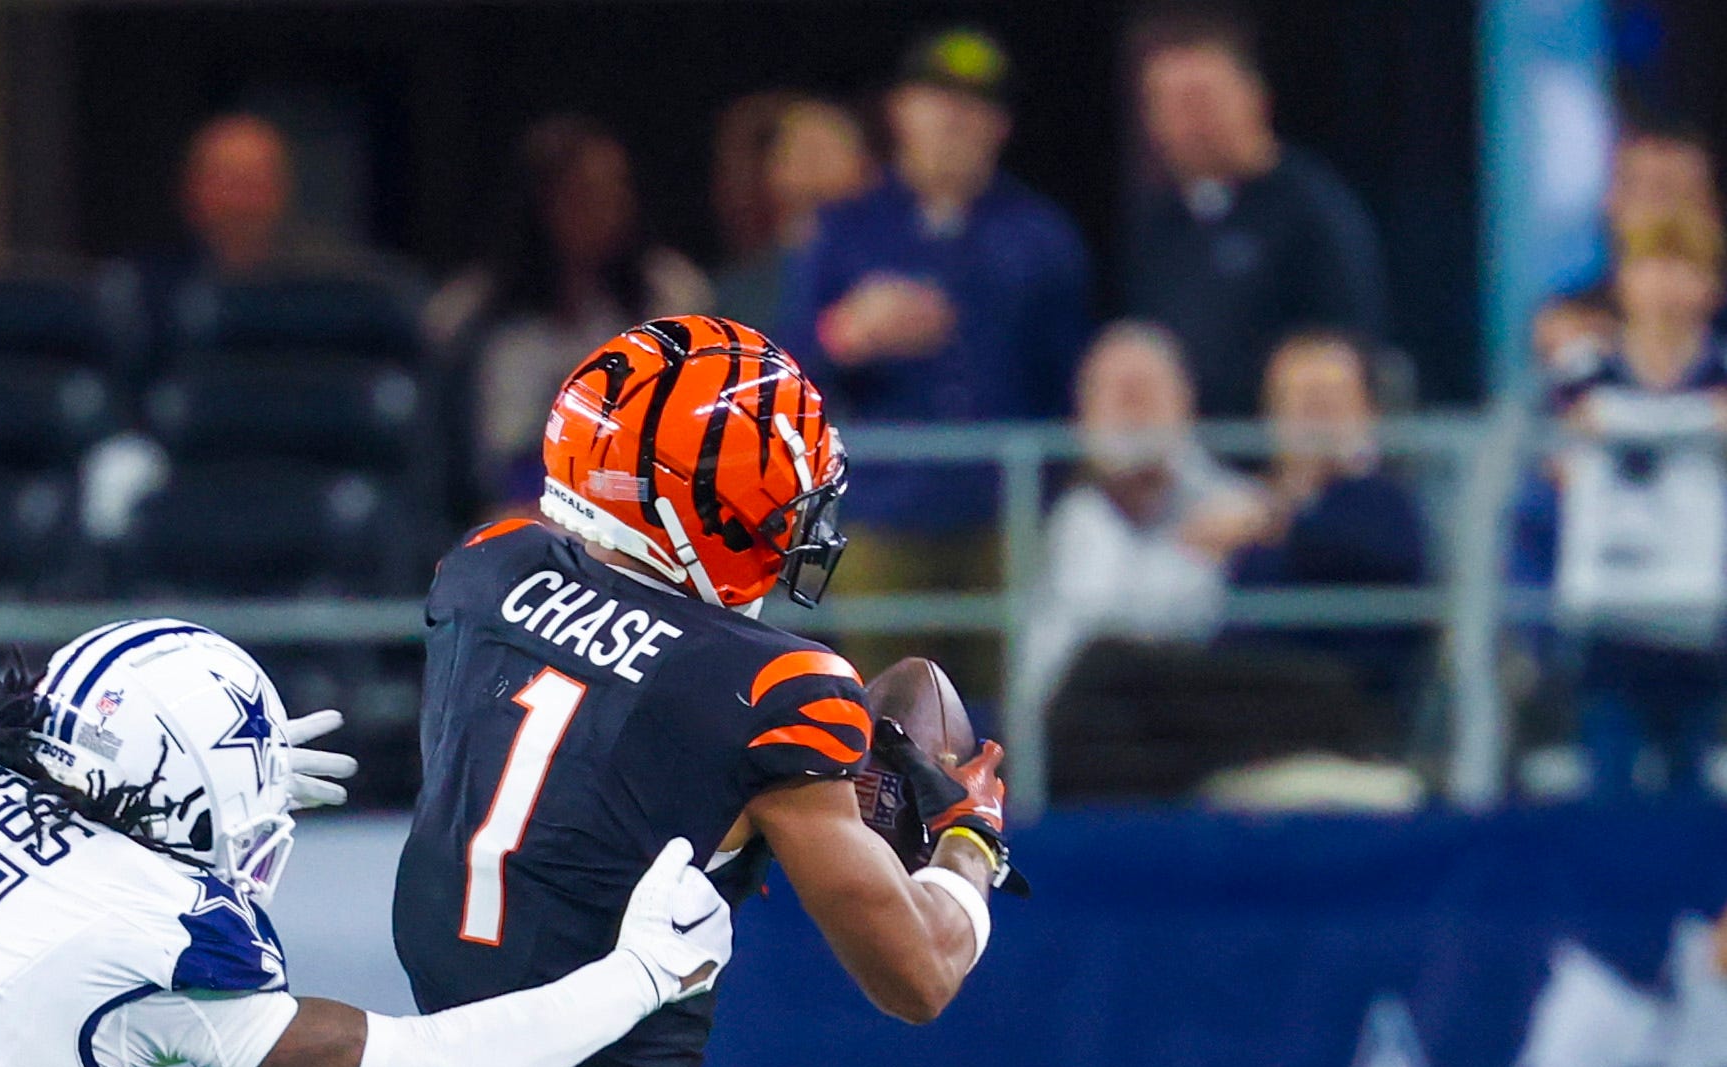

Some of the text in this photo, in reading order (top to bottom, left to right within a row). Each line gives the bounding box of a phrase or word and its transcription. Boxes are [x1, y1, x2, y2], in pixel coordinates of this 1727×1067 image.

[501, 570, 683, 683] CHASE
[37, 740, 76, 767] BOYS
[459, 665, 588, 946] 1
